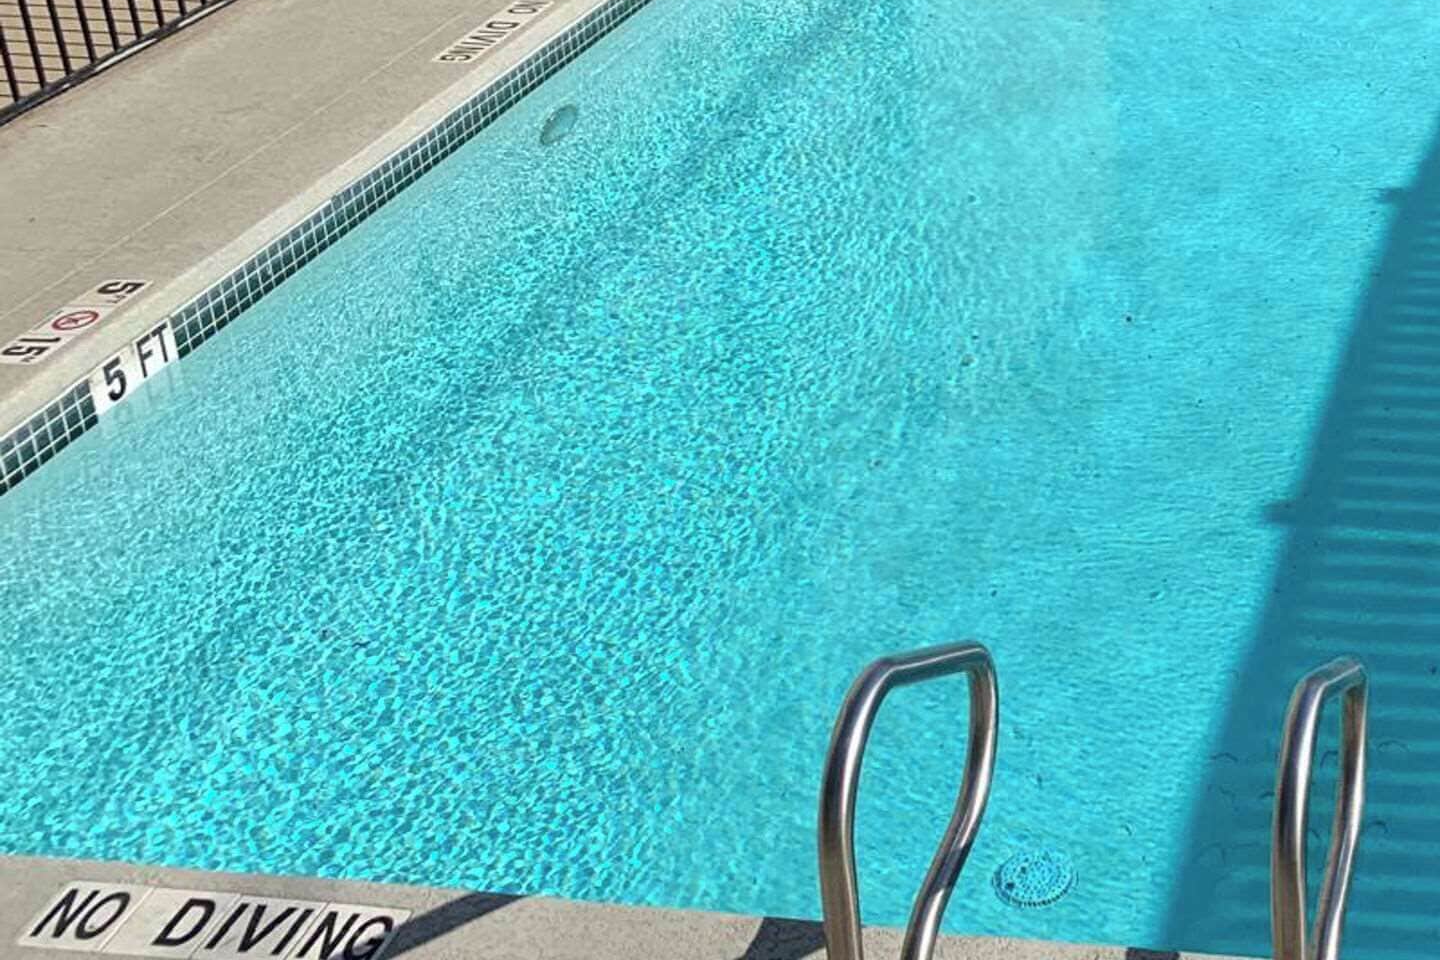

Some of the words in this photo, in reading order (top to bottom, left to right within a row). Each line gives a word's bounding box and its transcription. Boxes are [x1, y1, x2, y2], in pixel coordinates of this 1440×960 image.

[97, 281, 145, 295] 5
[103, 356, 128, 402] 5
[136, 322, 169, 379] FT
[30, 888, 131, 940] NO
[151, 898, 394, 960] DIVING
